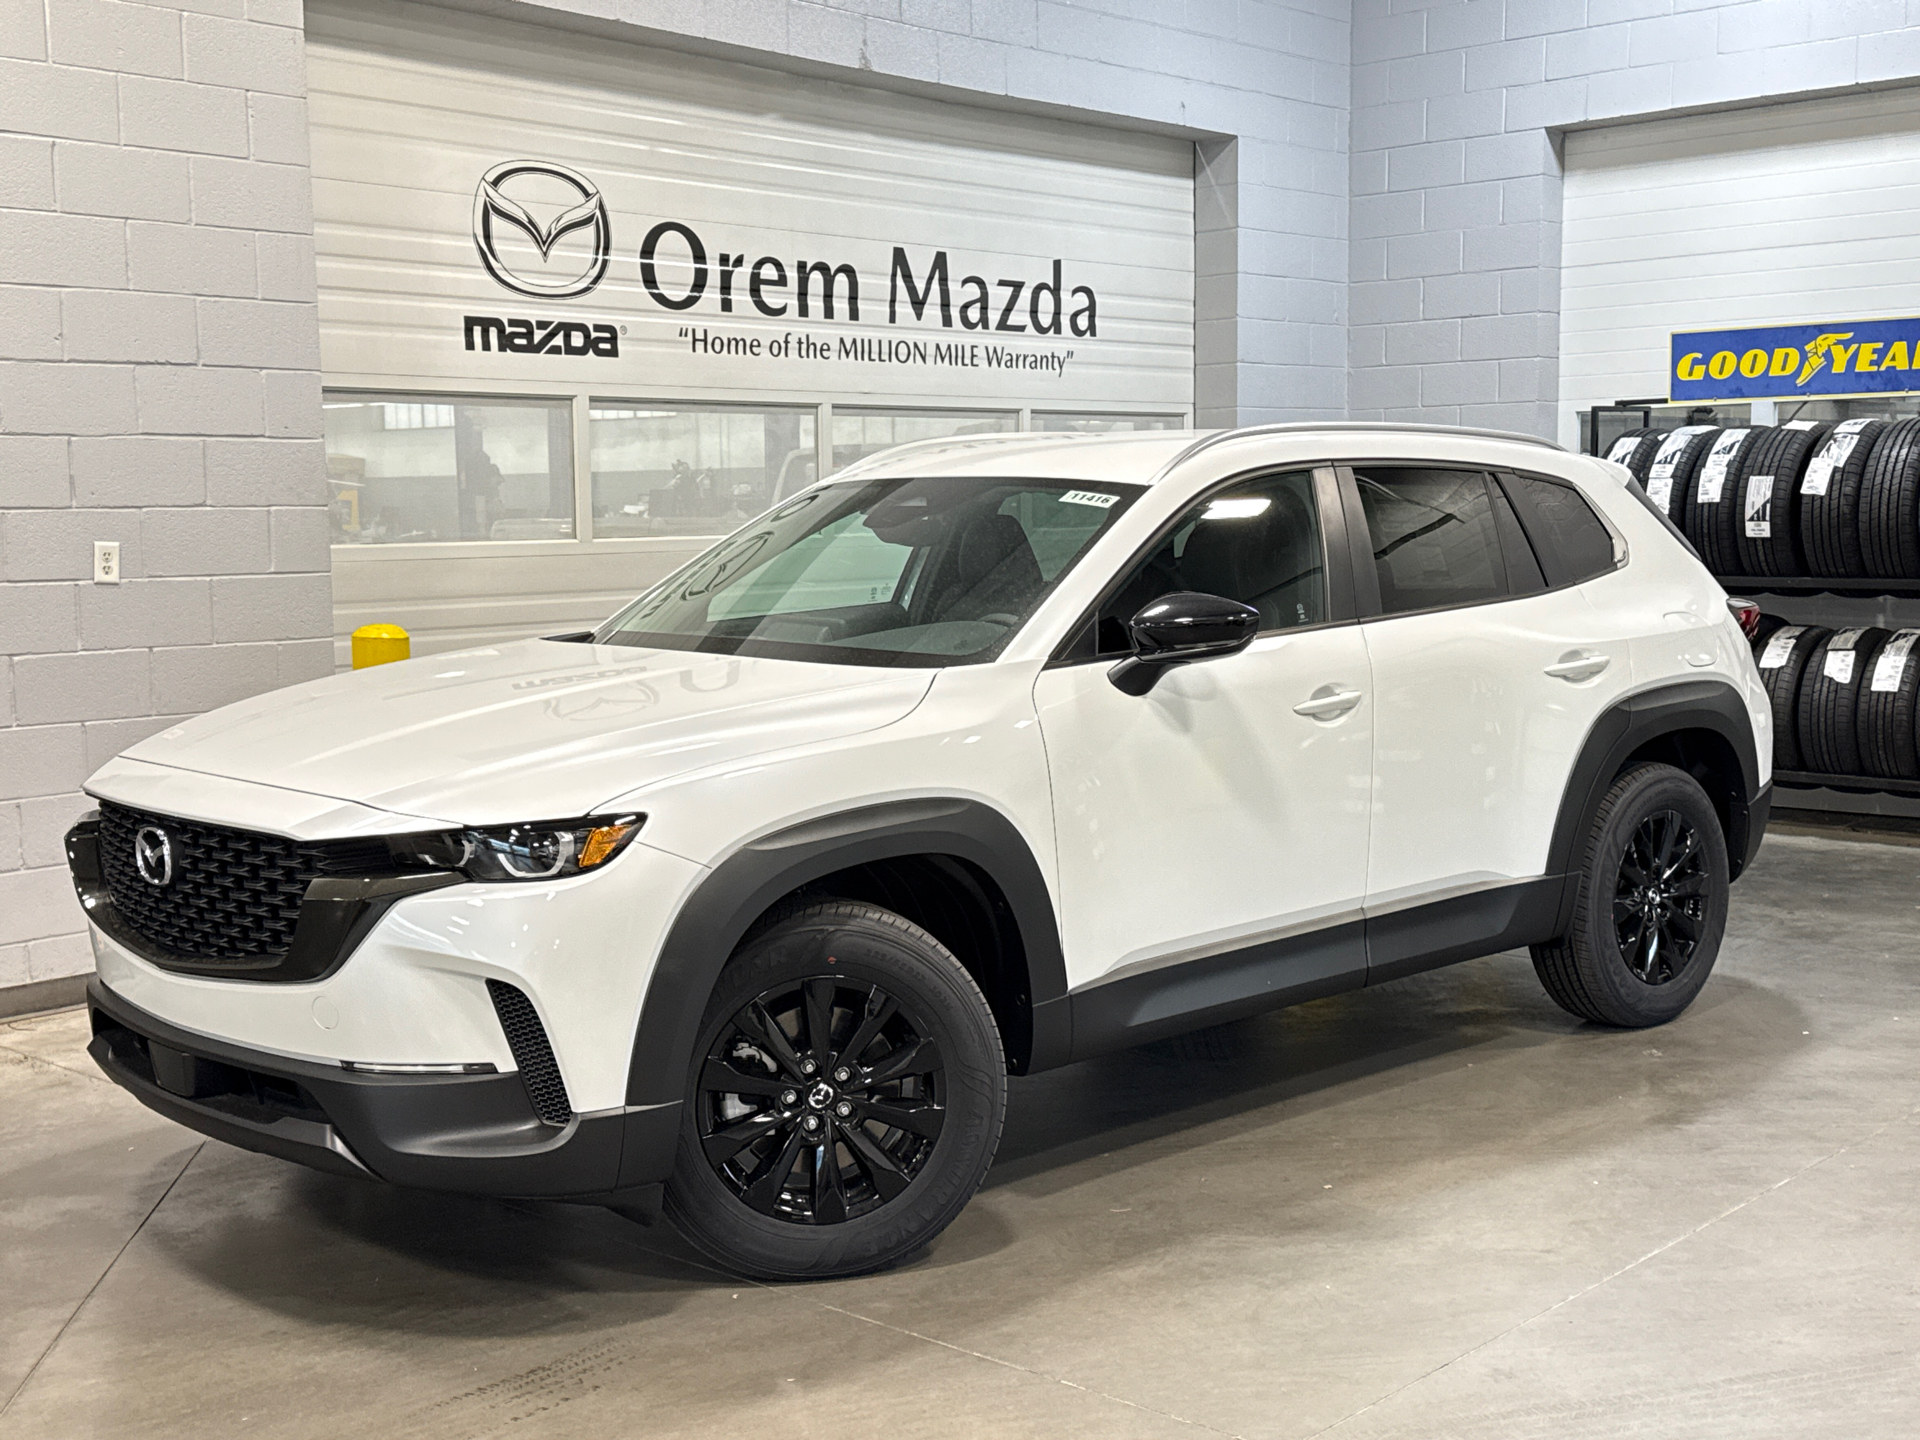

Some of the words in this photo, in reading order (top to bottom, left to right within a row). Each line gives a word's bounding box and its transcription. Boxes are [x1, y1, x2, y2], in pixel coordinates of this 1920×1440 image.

[640, 221, 859, 321] Orem
[889, 246, 1098, 337] Mazda
[770, 333, 798, 360] of
[797, 335, 832, 360] the
[837, 337, 928, 365] MILLION
[933, 343, 980, 367] MILE
[1072, 493, 1113, 504] 11416
